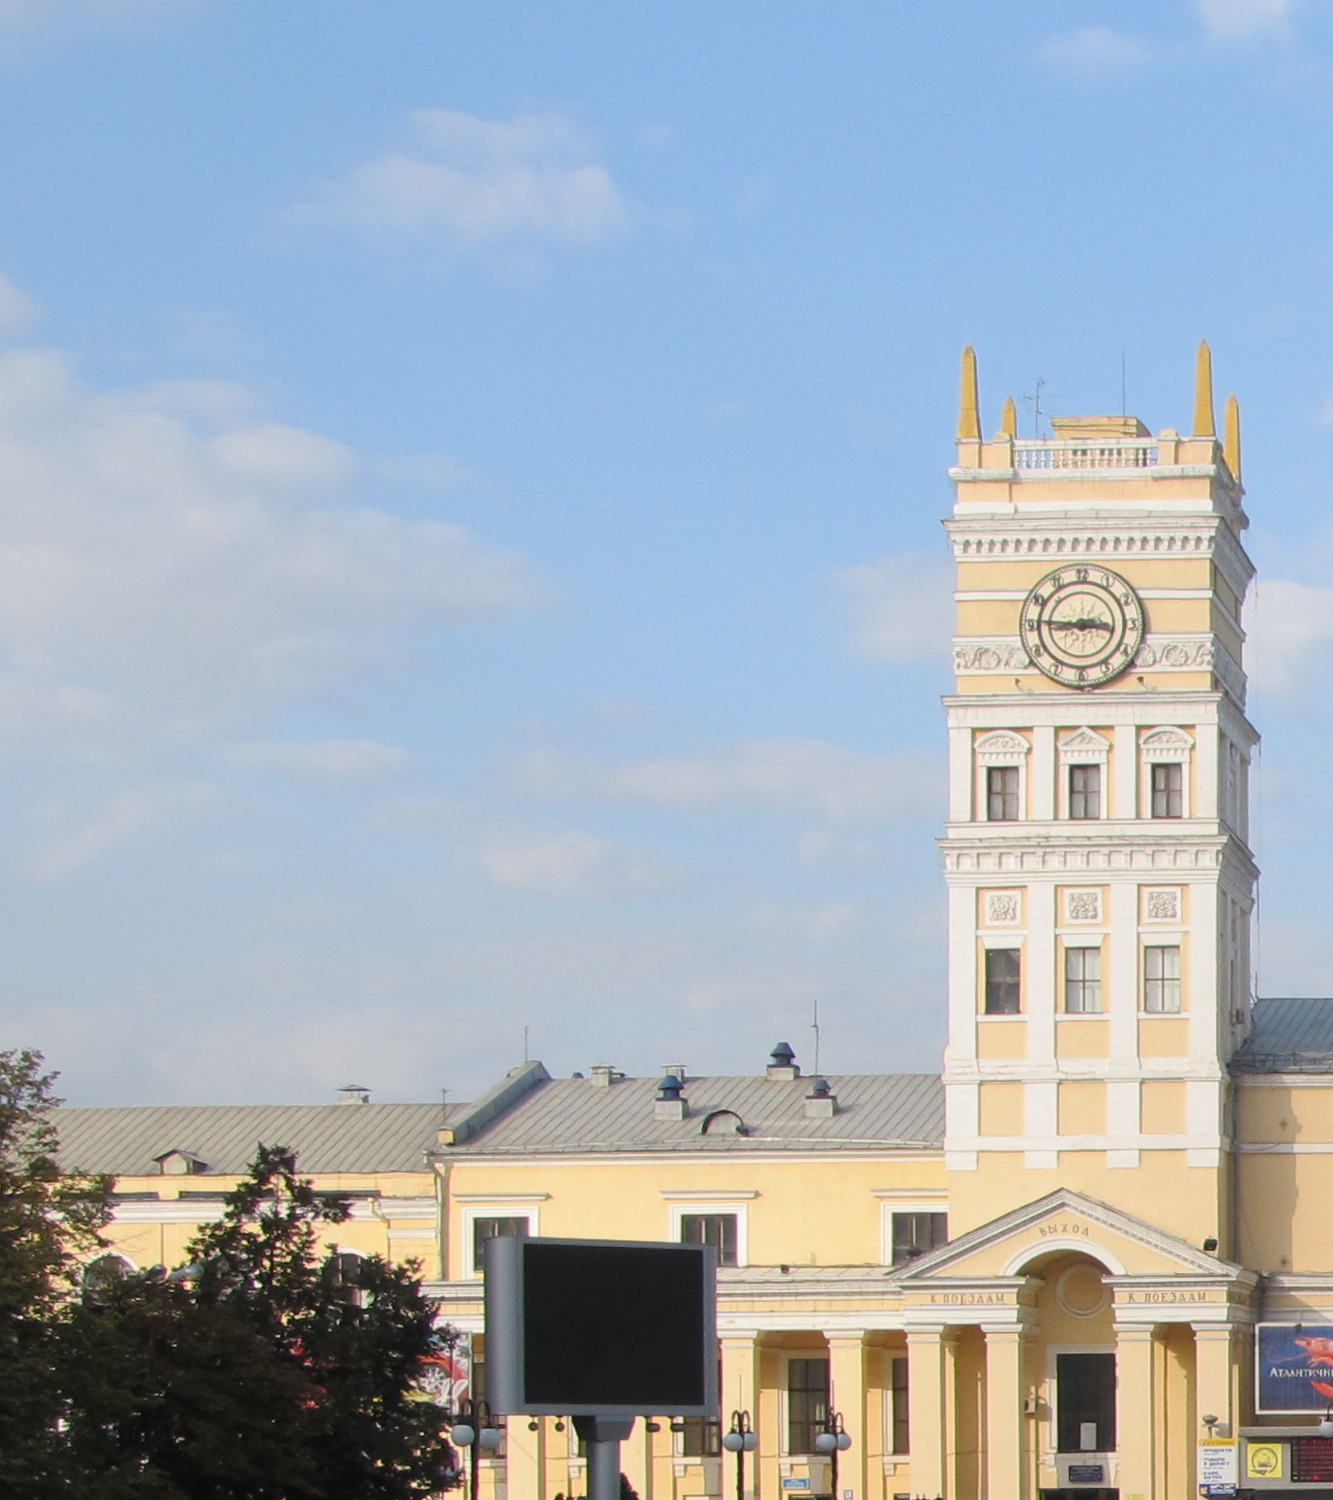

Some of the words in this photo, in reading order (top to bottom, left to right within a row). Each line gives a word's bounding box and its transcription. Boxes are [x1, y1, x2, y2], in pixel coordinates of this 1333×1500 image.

[1075, 568, 1089, 581] 12
[1039, 1223, 1091, 1237] ВЫХОД
[930, 1294, 937, 1304] К
[943, 1293, 1005, 1305] ПОЕЗДАМ
[1128, 1292, 1136, 1303] К
[1144, 1292, 1207, 1303] ПОЕЗДАМ
